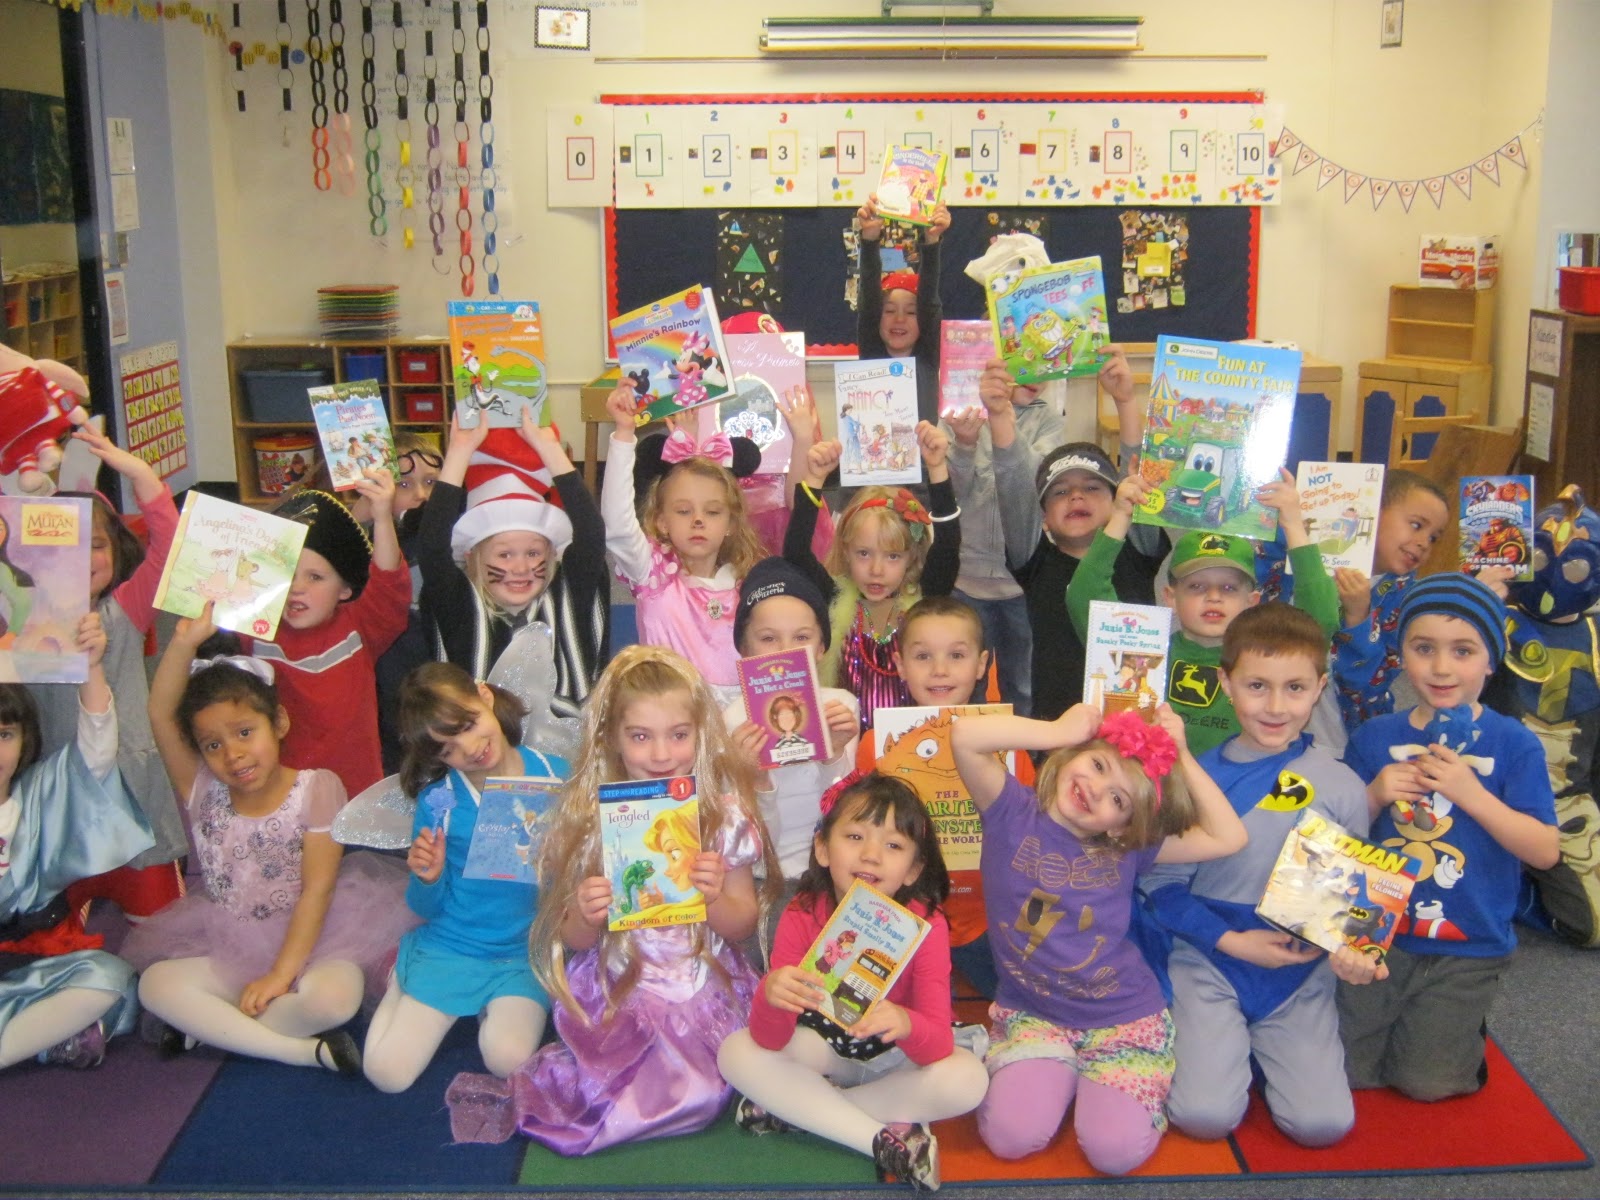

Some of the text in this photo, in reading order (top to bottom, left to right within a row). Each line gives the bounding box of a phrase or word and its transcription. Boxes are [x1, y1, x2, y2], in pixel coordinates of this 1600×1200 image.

[710, 110, 718, 122] 2
[779, 112, 788, 124] 3
[977, 109, 986, 121] 6
[1047, 110, 1056, 122] 7
[1179, 108, 1188, 120] 9
[1111, 117, 1120, 129] 8
[645, 148, 652, 163] 1
[711, 148, 722, 163] 2
[777, 145, 788, 160] 3
[845, 145, 856, 159] 4
[980, 143, 990, 158] 6
[1046, 144, 1056, 159] 7
[1113, 146, 1123, 160] 8
[1179, 144, 1189, 158] 9
[1241, 146, 1260, 162] 10
[575, 151, 585, 166] 0
[1011, 274, 1072, 303] SPONGEBOB
[1043, 289, 1068, 304] TEES
[626, 318, 701, 352] Minnie's Rainbow
[867, 369, 887, 378] Read!
[894, 365, 898, 373] 1
[1218, 355, 1268, 374] FUN AT
[1175, 367, 1294, 394] THE COUNTY FAIR
[335, 404, 367, 415] Pirates
[1316, 465, 1328, 473] Am
[1308, 473, 1333, 487] NOT
[1301, 487, 1330, 499] Going
[1301, 488, 1361, 511] Get up Today!
[28, 513, 74, 530] MULAN
[196, 514, 253, 536] Angelina's
[1332, 557, 1351, 566] Seuss
[1466, 556, 1510, 564] MACHINE
[1123, 624, 1134, 634] B.
[1135, 624, 1160, 636] Jones
[748, 669, 807, 687] Junie B. Jones
[754, 686, 762, 694] Is
[763, 684, 777, 693] Not
[784, 679, 805, 689] Crook
[1182, 712, 1231, 730] DEERE
[604, 789, 620, 798] STEP
[630, 787, 660, 796] READING
[679, 782, 685, 794] 1
[935, 790, 959, 799] THE
[924, 798, 976, 816] ARIE
[605, 809, 651, 829] Tangled
[934, 819, 983, 834] NSTE
[951, 835, 982, 844] WORL
[1299, 816, 1408, 875] BATMAN
[1378, 877, 1403, 891] FELINE
[1371, 883, 1404, 901] FELONIES
[619, 912, 698, 928] Kingdom of Color
[850, 902, 873, 922] Junie
[882, 923, 906, 943] Jones
[843, 914, 897, 953] Stupid Smelly Bus
